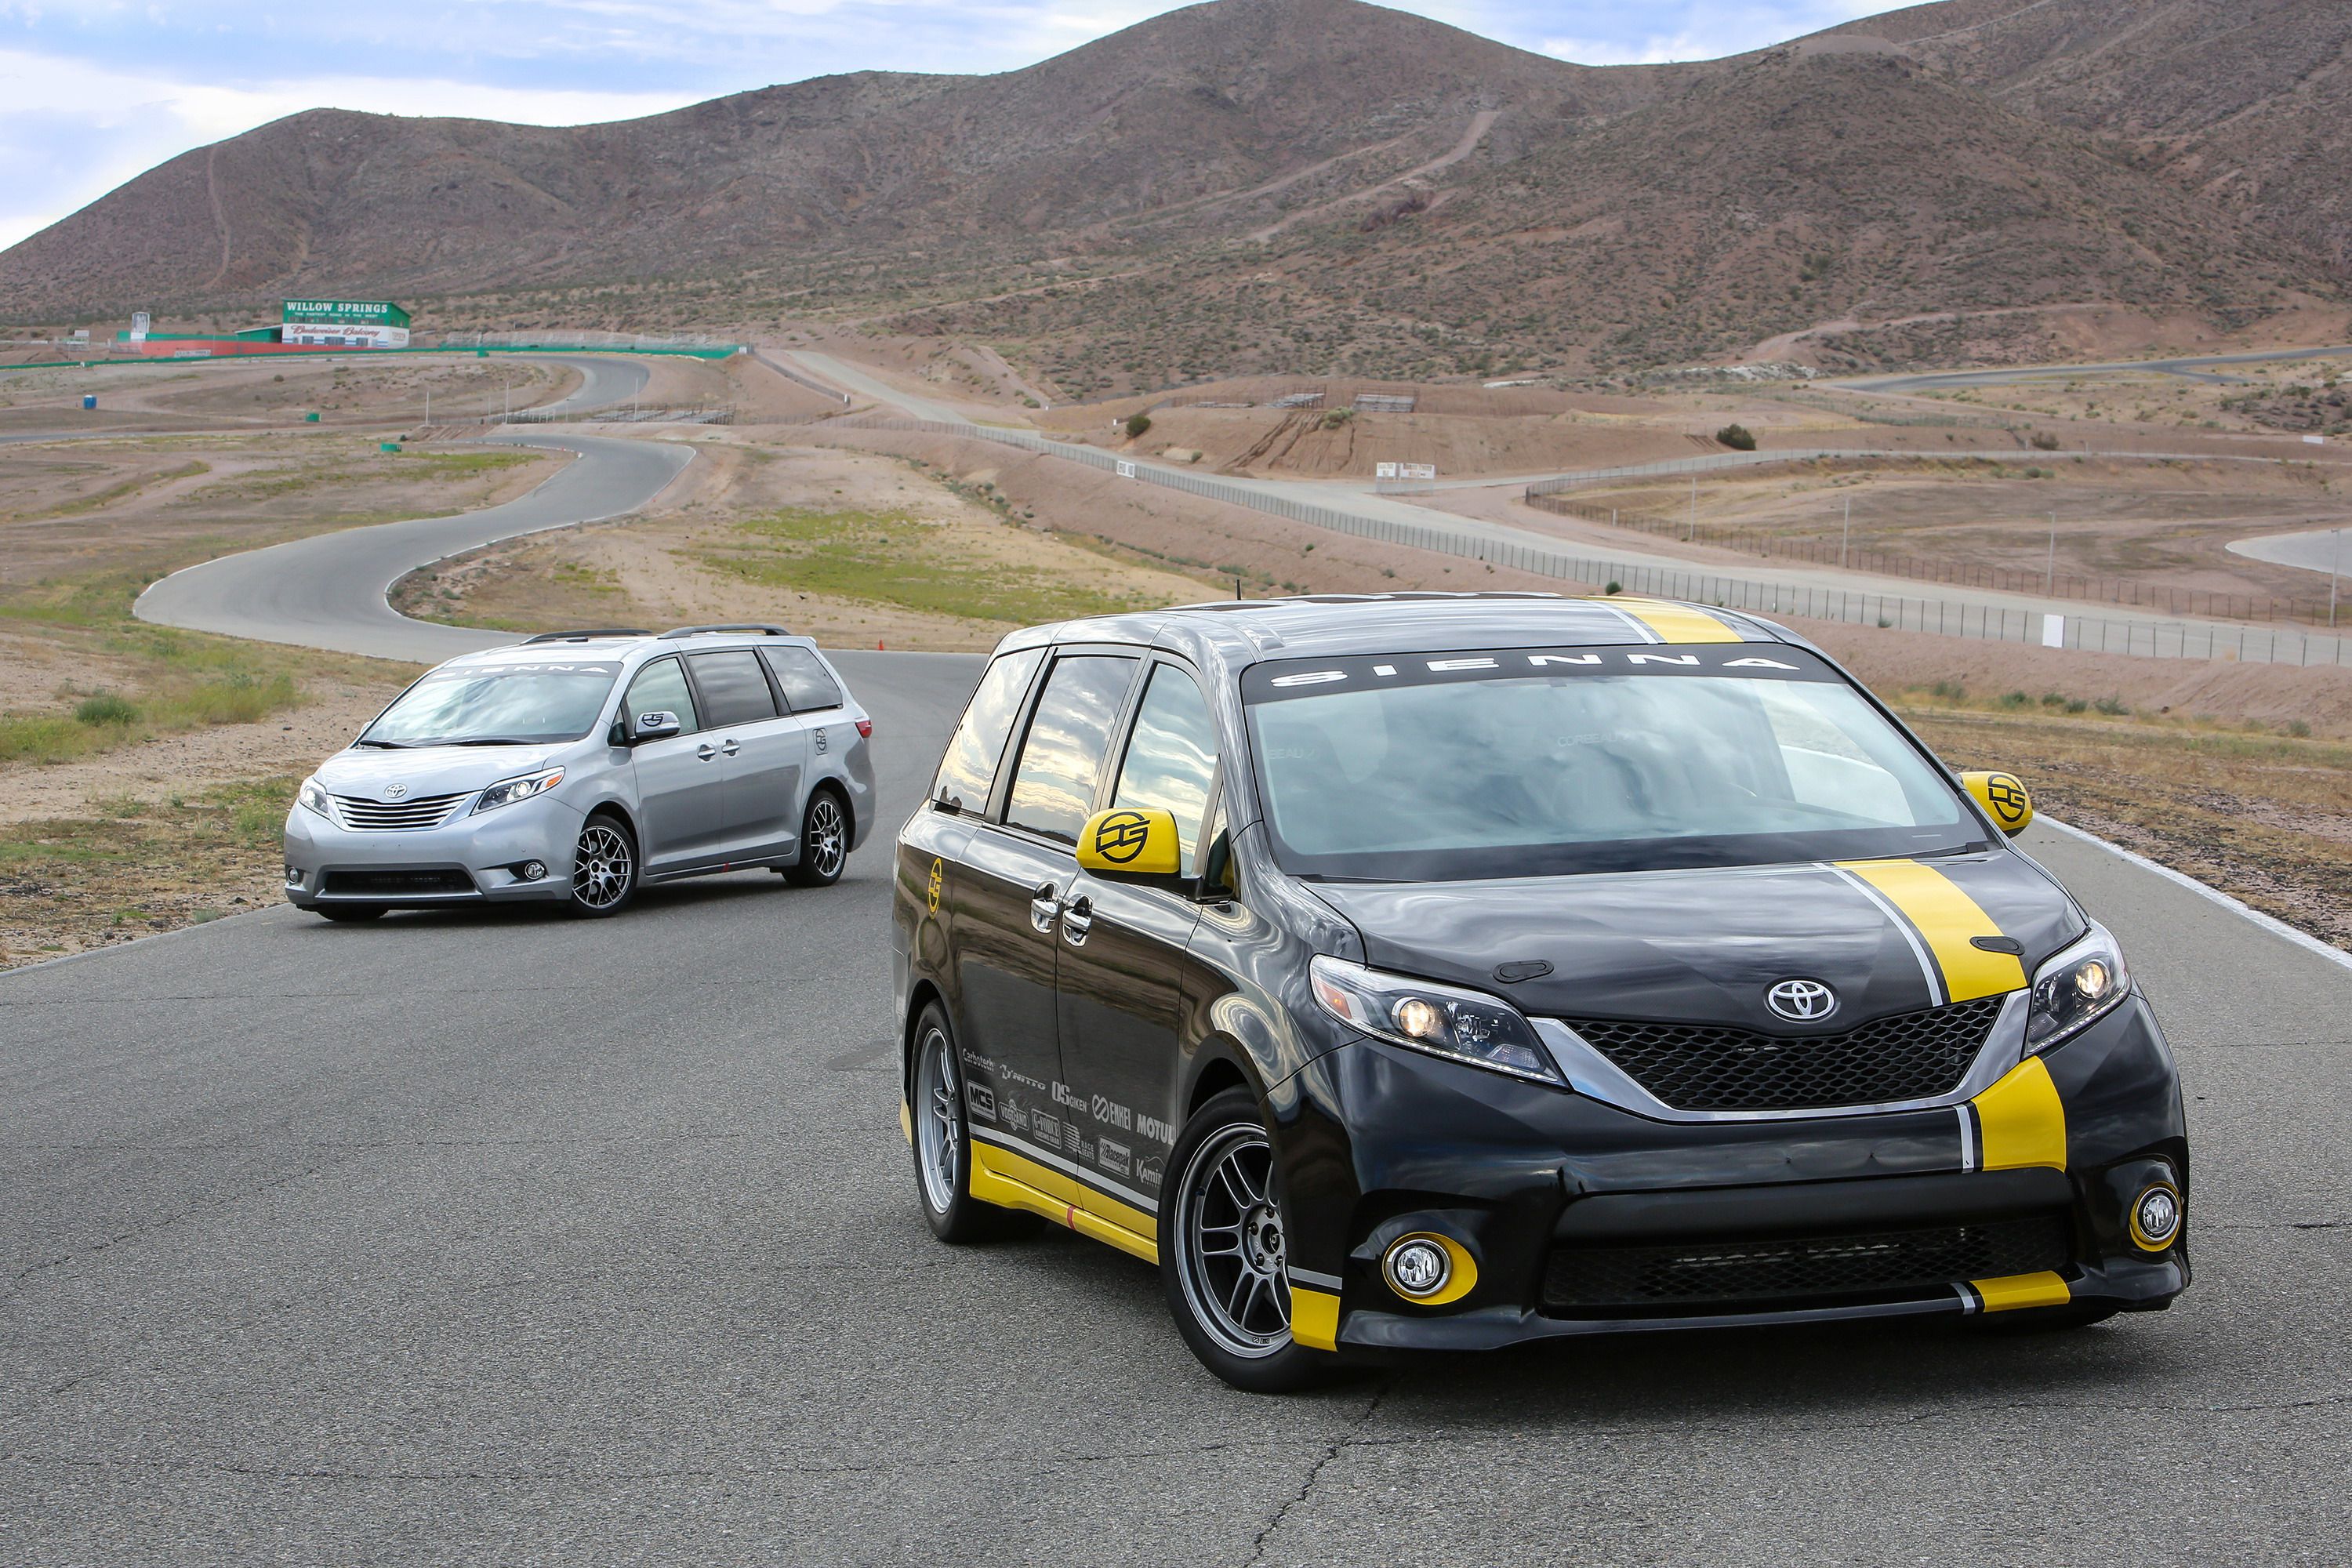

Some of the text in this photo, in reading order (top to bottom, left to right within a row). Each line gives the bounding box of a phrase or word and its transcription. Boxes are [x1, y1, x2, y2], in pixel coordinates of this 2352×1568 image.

[287, 302, 387, 313] WILLOW SPRINGS
[291, 325, 340, 334] Budweiser
[343, 327, 380, 337] Balcony
[432, 666, 608, 680] SIENNA
[1270, 653, 1801, 688] SIENNA
[970, 1086, 993, 1110] MCS
[1051, 1081, 1087, 1113] OS GIKEN
[1109, 1102, 1131, 1131] ENKEI
[1136, 1113, 1175, 1145] MOTUL
[1080, 1140, 1094, 1152] RACE
